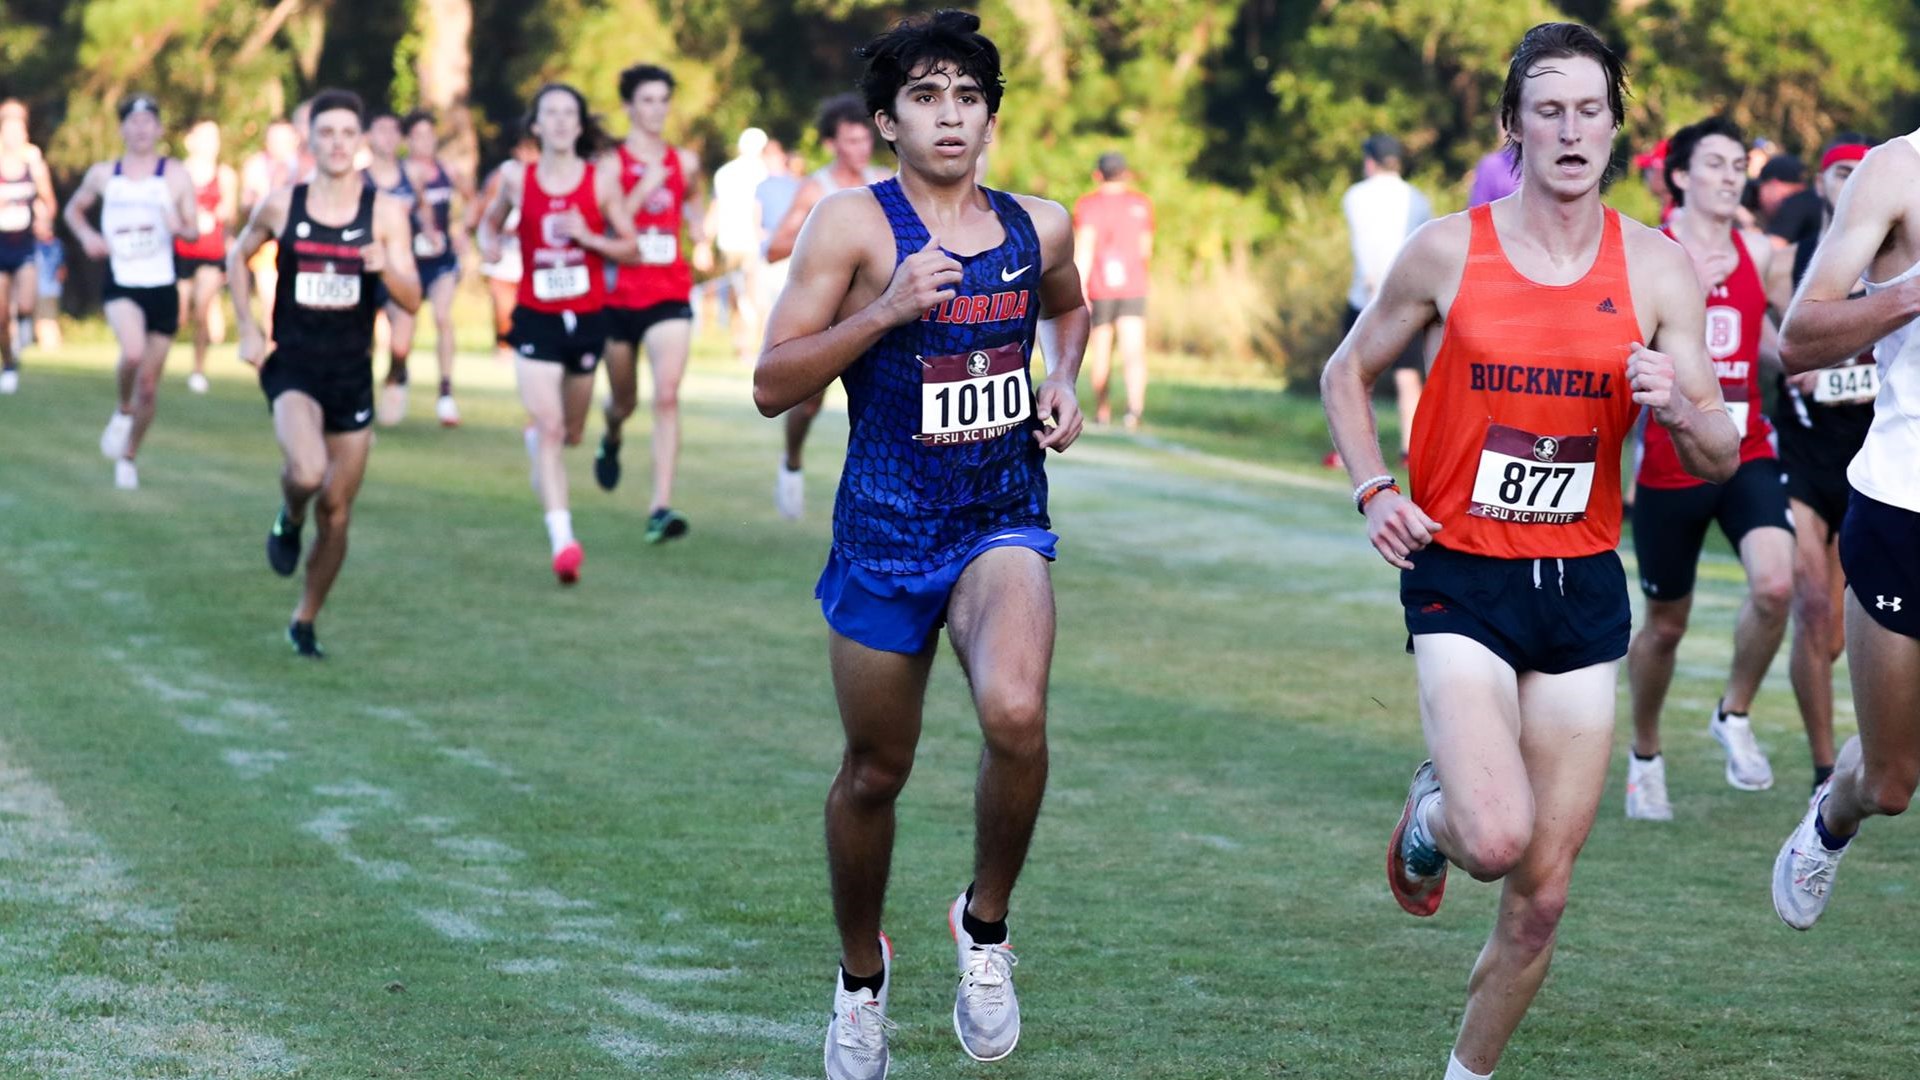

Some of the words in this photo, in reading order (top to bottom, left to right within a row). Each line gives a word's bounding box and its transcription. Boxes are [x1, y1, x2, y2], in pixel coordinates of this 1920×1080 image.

[920, 290, 1029, 325] FLORIDA
[1470, 363, 1614, 399] BUCKNELL
[1828, 369, 1873, 396] 944
[935, 375, 1021, 428] 1010
[934, 432, 959, 444] FSU
[963, 430, 980, 442] XC
[1499, 461, 1576, 508] 877
[1481, 505, 1508, 521] FSU
[1512, 511, 1531, 523] XC
[1533, 511, 1574, 524] INVITE
